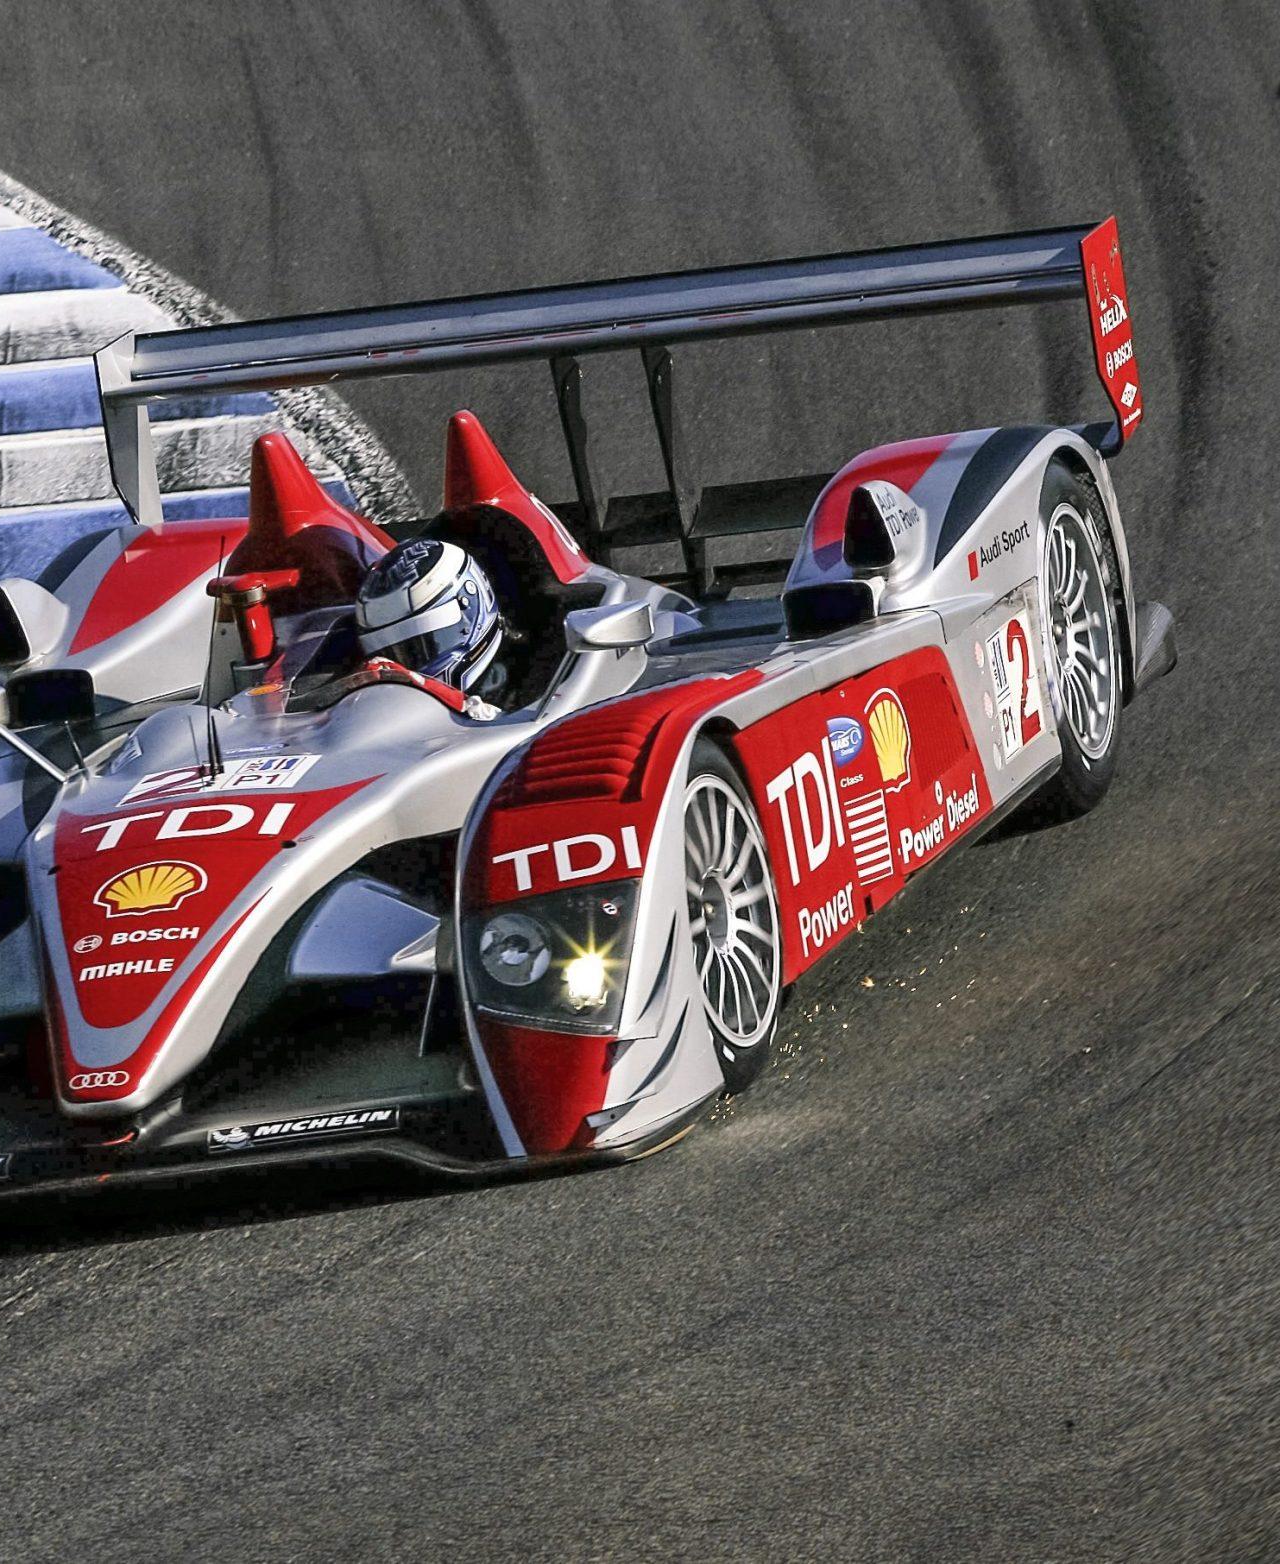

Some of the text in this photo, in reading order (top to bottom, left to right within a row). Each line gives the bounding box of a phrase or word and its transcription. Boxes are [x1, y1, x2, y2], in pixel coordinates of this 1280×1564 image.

[1113, 339, 1134, 371] BOSCH
[979, 520, 1030, 568] Audi Sport
[1007, 618, 1042, 747] 2
[233, 774, 281, 786] P1
[840, 774, 864, 788] Class
[946, 772, 979, 832] Diesel
[81, 803, 296, 852] TDI
[766, 736, 846, 887] TDI
[492, 825, 642, 892] TDI
[110, 927, 200, 946] BOSCH
[798, 881, 854, 958] Power
[79, 958, 175, 982] MAHLE
[253, 1110, 393, 1137] MICHELIN
